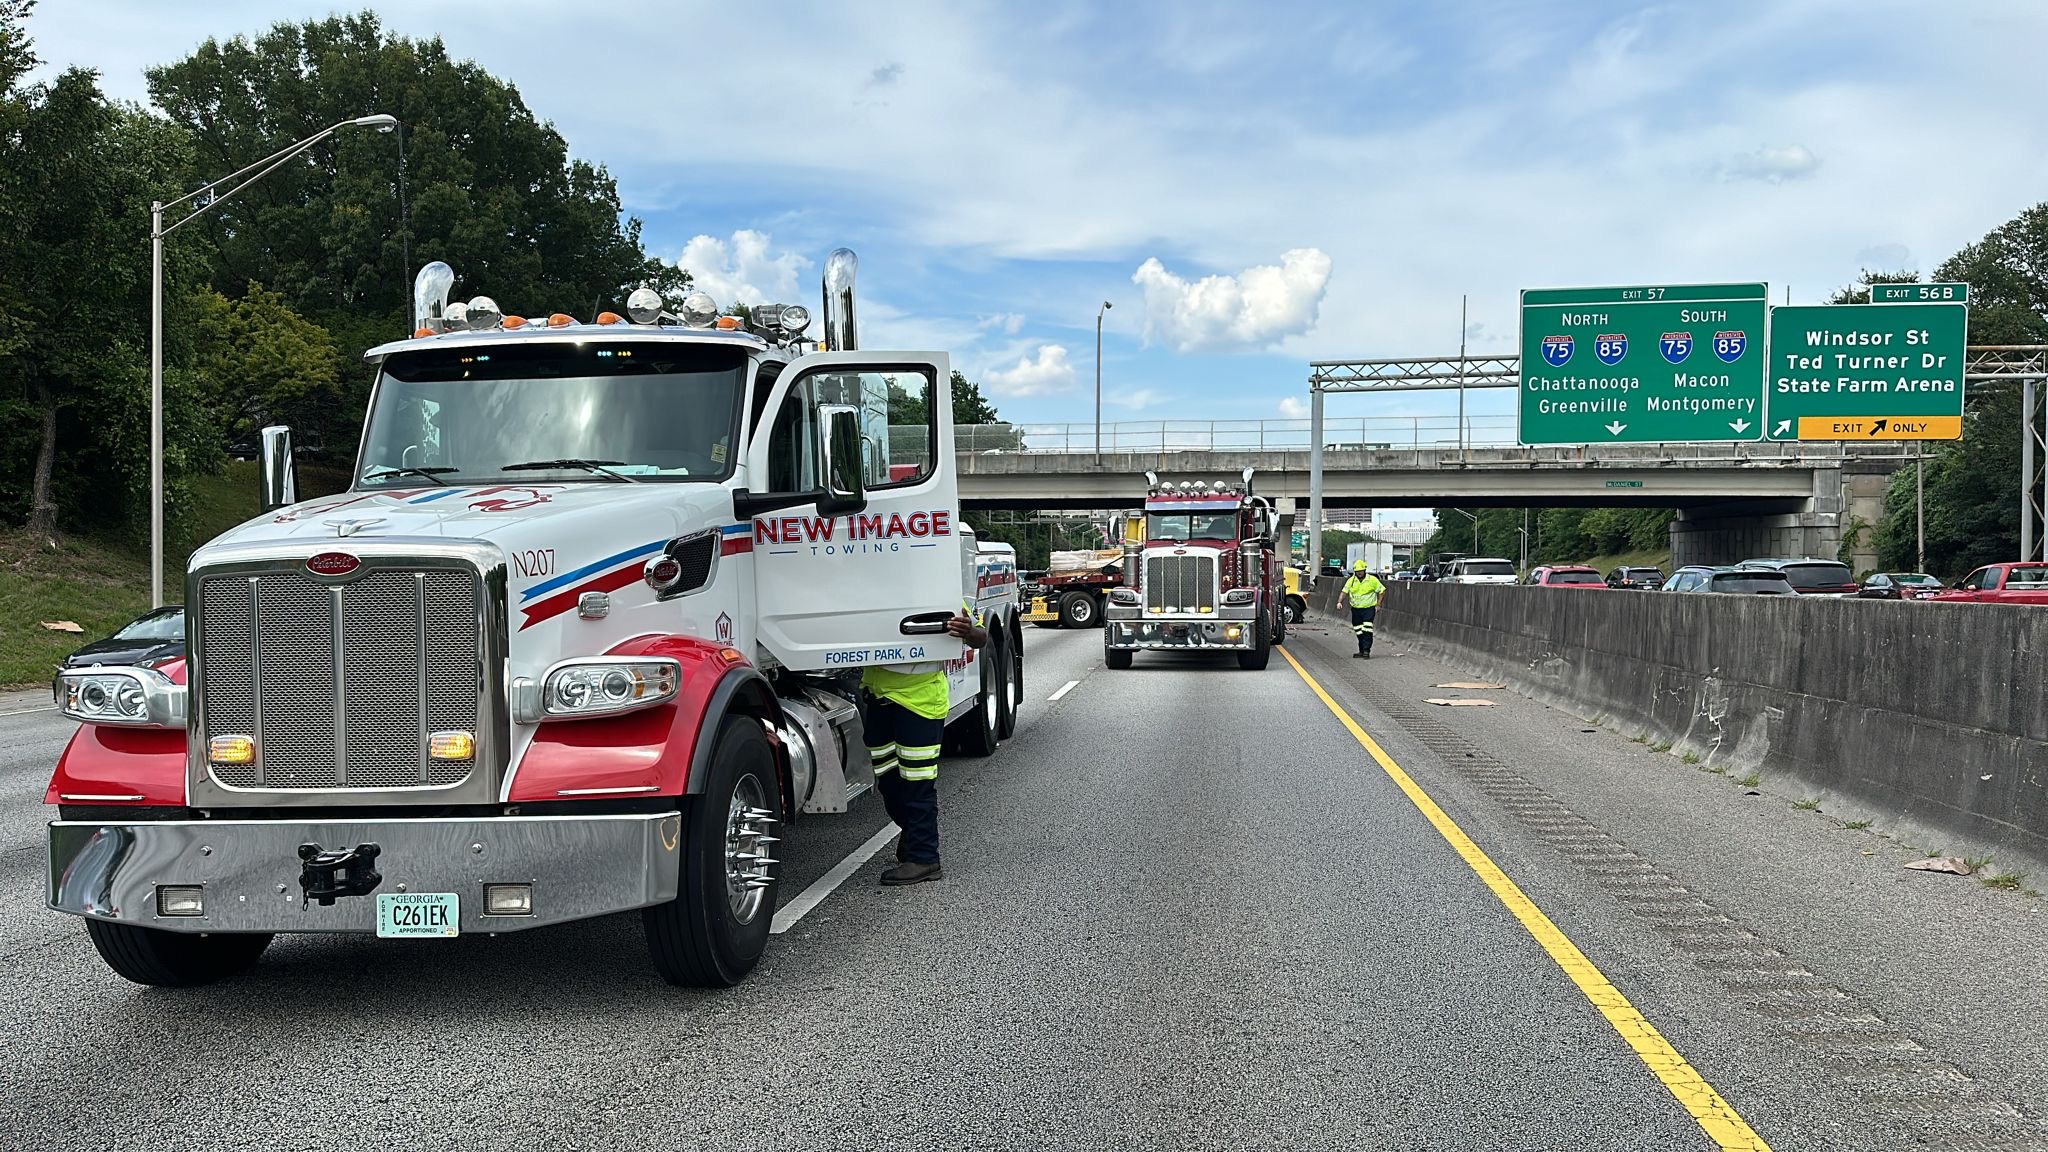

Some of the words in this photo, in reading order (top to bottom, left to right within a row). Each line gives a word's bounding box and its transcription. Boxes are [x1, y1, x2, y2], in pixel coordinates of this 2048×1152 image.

[1622, 290, 1642, 299] EXIT
[1647, 288, 1665, 300] 57
[1886, 289, 1910, 298] EXIT
[1562, 312, 1608, 326] NORTH
[1681, 309, 1727, 322] SOUTH
[1806, 330, 1893, 346] Windsor
[1906, 329, 1929, 345] St
[1546, 343, 1569, 358] 75
[1600, 342, 1622, 357] 85
[1664, 340, 1687, 355] 75
[1718, 339, 1741, 354] 85
[1786, 354, 1823, 370] Ted
[1834, 354, 1910, 369] Turner
[1921, 353, 1947, 368] Dr
[1528, 376, 1639, 394] Chattanooga
[1674, 373, 1729, 388] Macon
[1777, 377, 1831, 393] State
[1836, 377, 1888, 393] Farm
[1894, 376, 1955, 392] Arena
[1539, 398, 1627, 414] Greenville
[1647, 396, 1756, 415] Montgomery
[1833, 424, 1863, 433] EXIT
[1893, 423, 1928, 433] ONLY
[753, 515, 837, 545] NEW
[848, 510, 951, 541] IMAGE
[811, 543, 899, 556] TOWING
[511, 549, 555, 579] N207
[826, 651, 870, 664] FOREST
[874, 648, 905, 661] PARK,
[909, 647, 925, 659] GA
[395, 895, 440, 904] GEORGIA
[393, 905, 448, 926] C261EK
